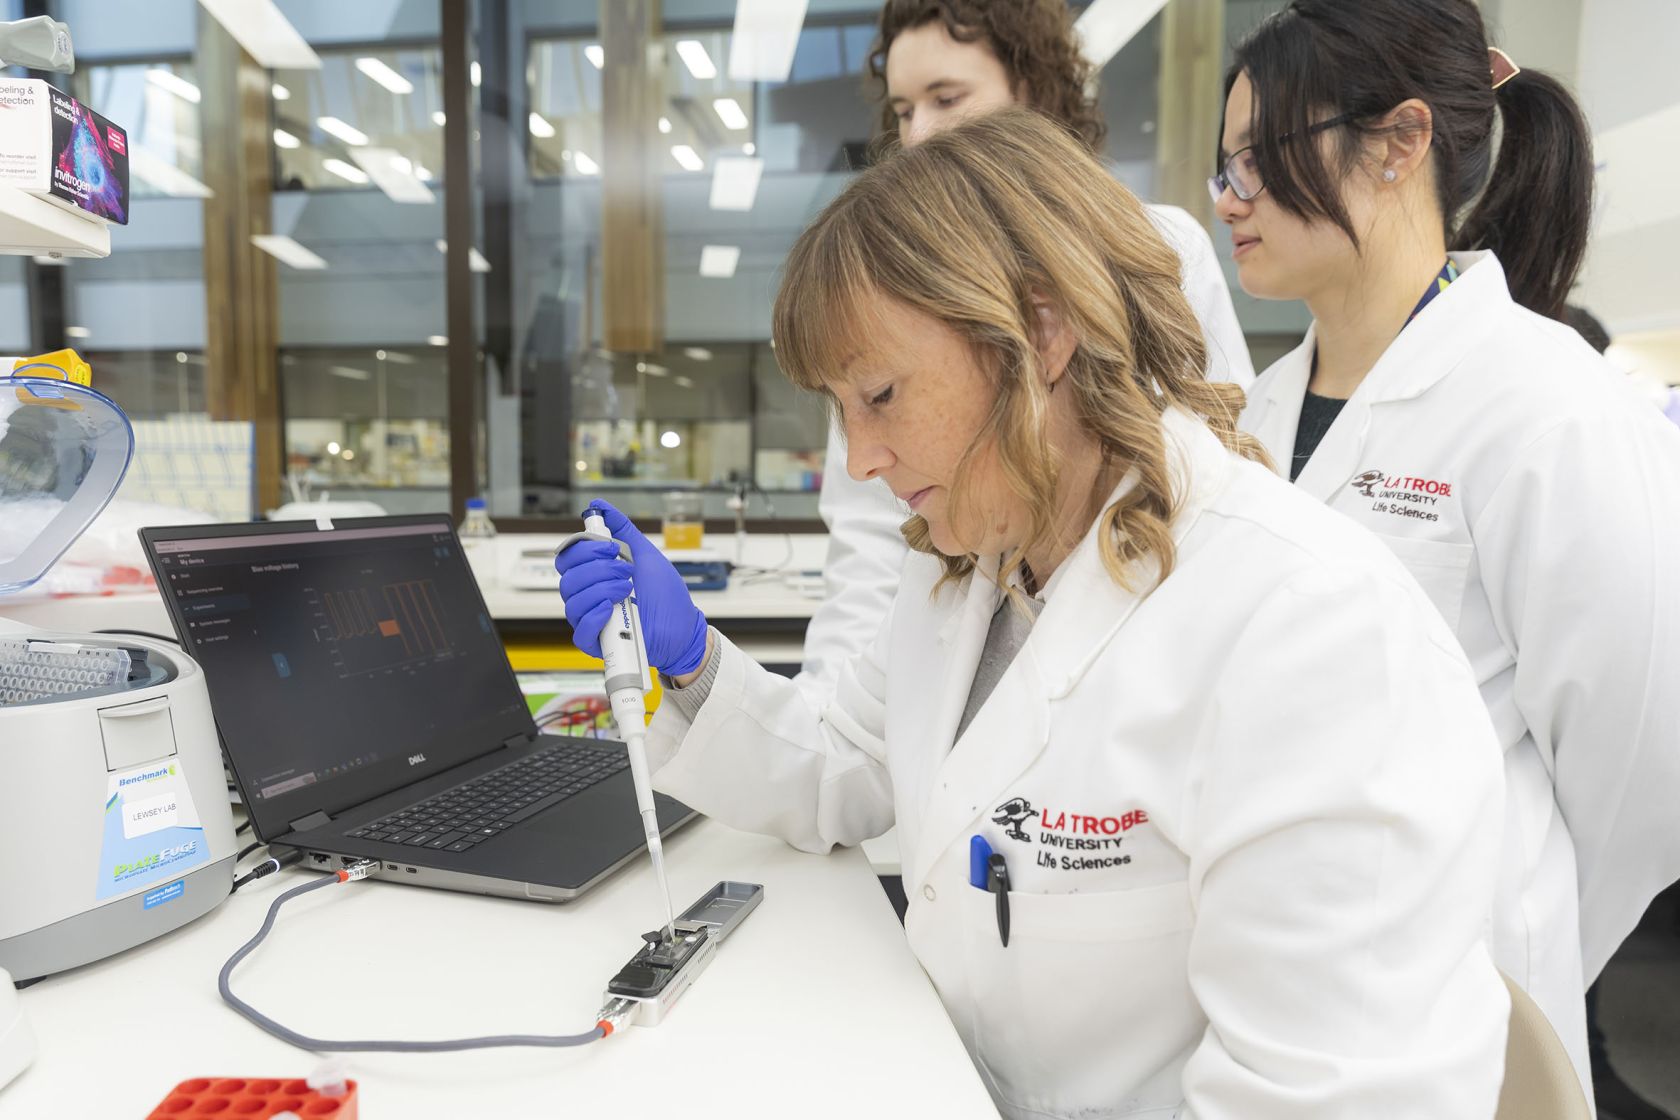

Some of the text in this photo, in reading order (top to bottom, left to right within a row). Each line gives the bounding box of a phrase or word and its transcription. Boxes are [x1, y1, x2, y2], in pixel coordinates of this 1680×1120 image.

[28, 86, 33, 94] &
[52, 94, 76, 116] Labeling
[54, 106, 79, 125] detection
[55, 165, 92, 192] invitrogen
[1384, 477, 1401, 489] LA
[1379, 490, 1438, 506] UNIVERSITY
[1372, 501, 1440, 522] Life Sciences
[408, 753, 426, 766] DELL
[119, 768, 168, 787] Benchmark
[132, 803, 176, 822] LEWSEY LAB
[1041, 808, 1149, 835] LA TROBE
[1040, 832, 1122, 851] UNIVERSITY
[1037, 850, 1131, 870] Life Sciences
